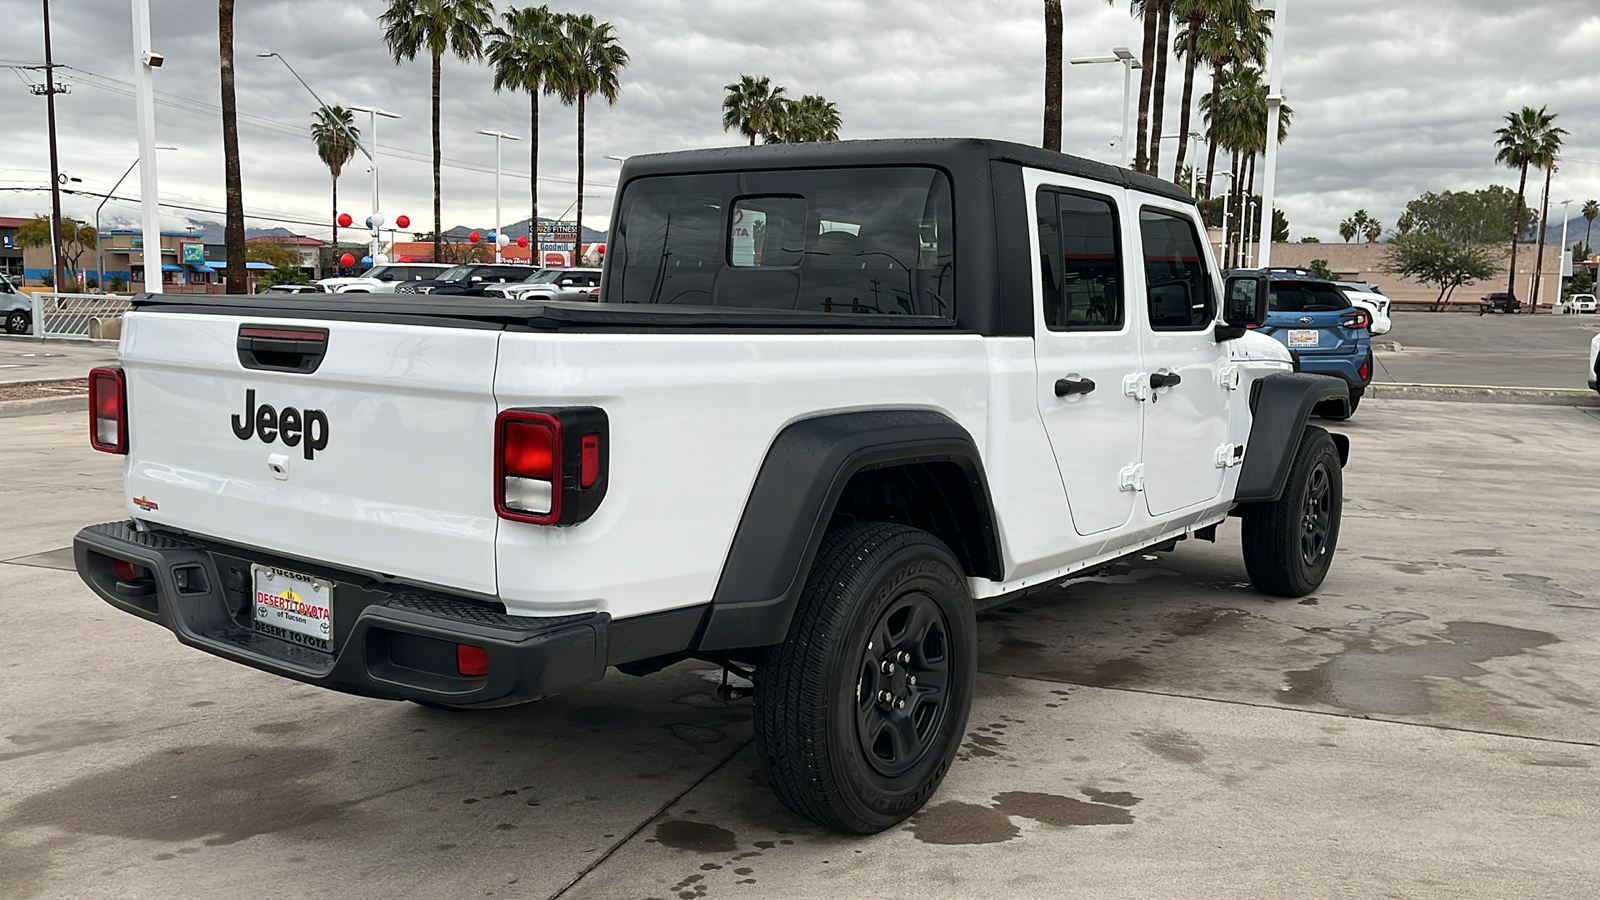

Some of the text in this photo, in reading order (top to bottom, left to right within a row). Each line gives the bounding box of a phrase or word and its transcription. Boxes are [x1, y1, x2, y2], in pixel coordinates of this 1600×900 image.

[231, 388, 329, 460] Jeep
[271, 567, 311, 582] TUCSON
[257, 591, 330, 620] DESERT TOYOTA
[285, 612, 307, 624] Tucson
[254, 621, 328, 650] DESERT TOYOTA
